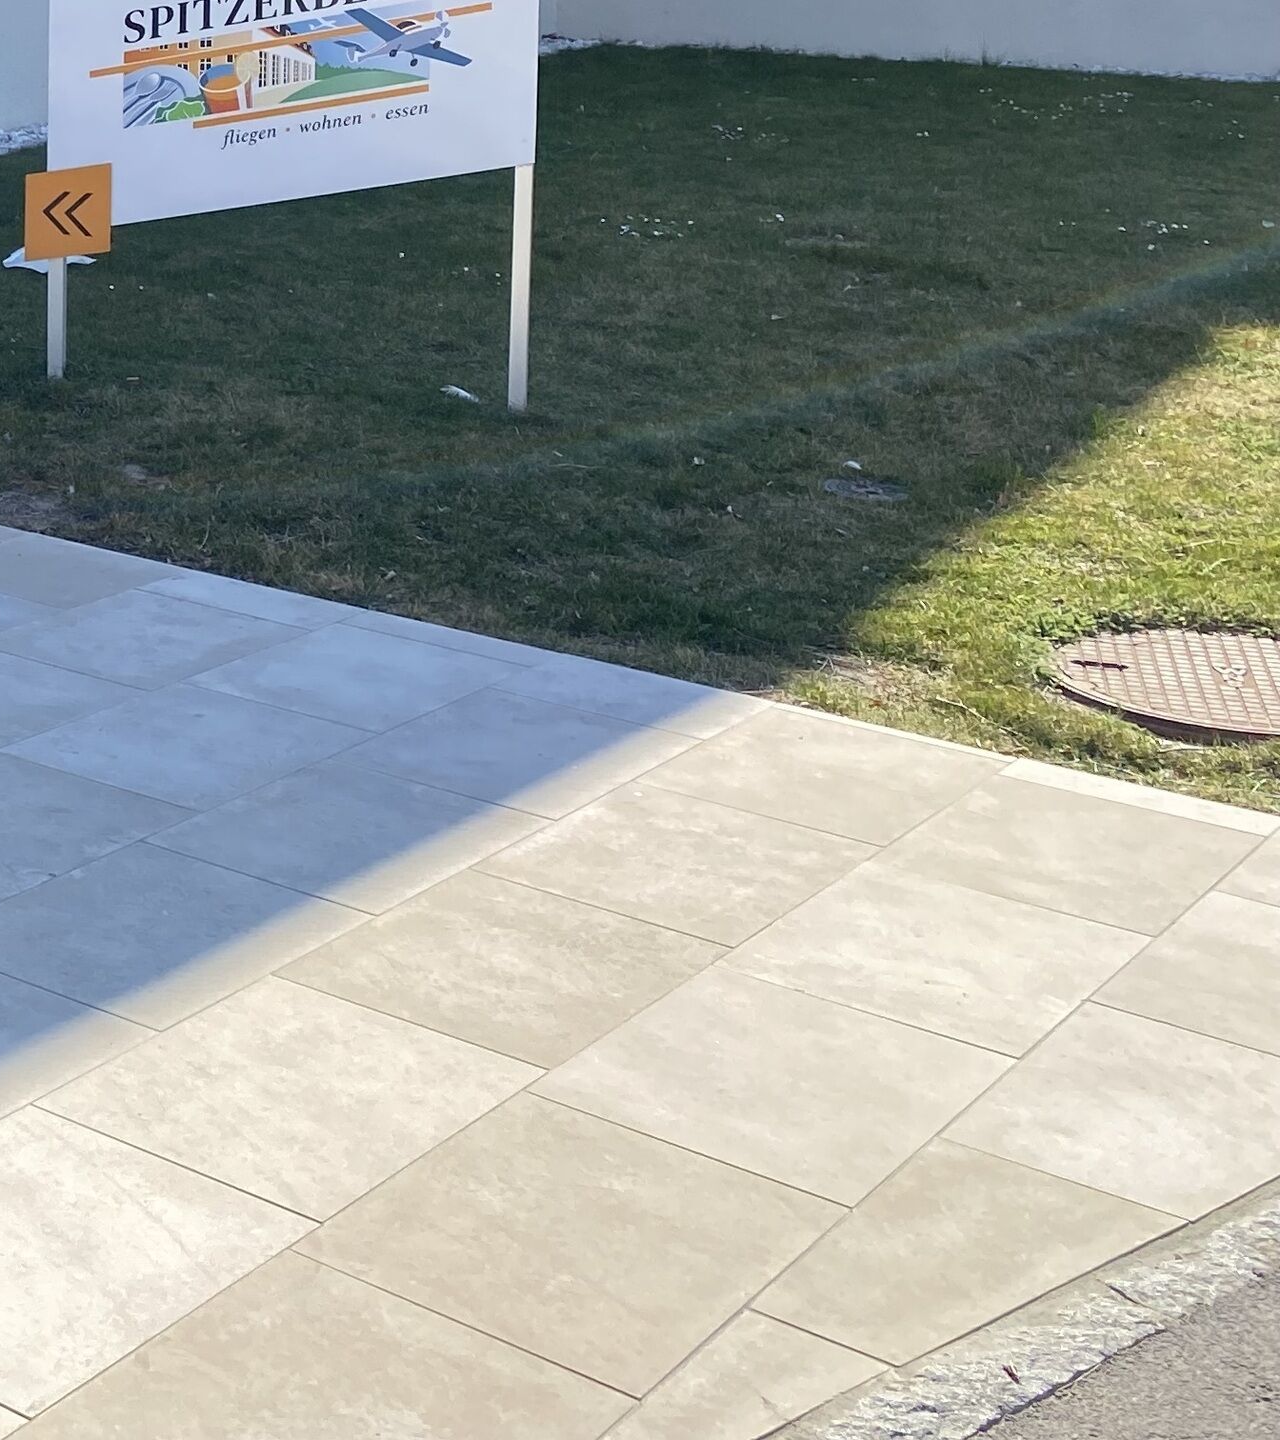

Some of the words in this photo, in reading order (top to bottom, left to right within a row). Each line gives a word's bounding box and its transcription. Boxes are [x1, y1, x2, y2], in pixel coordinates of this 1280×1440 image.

[220, 126, 277, 149] fliegen
[299, 112, 362, 134] wohnen
[385, 103, 429, 120] essen
